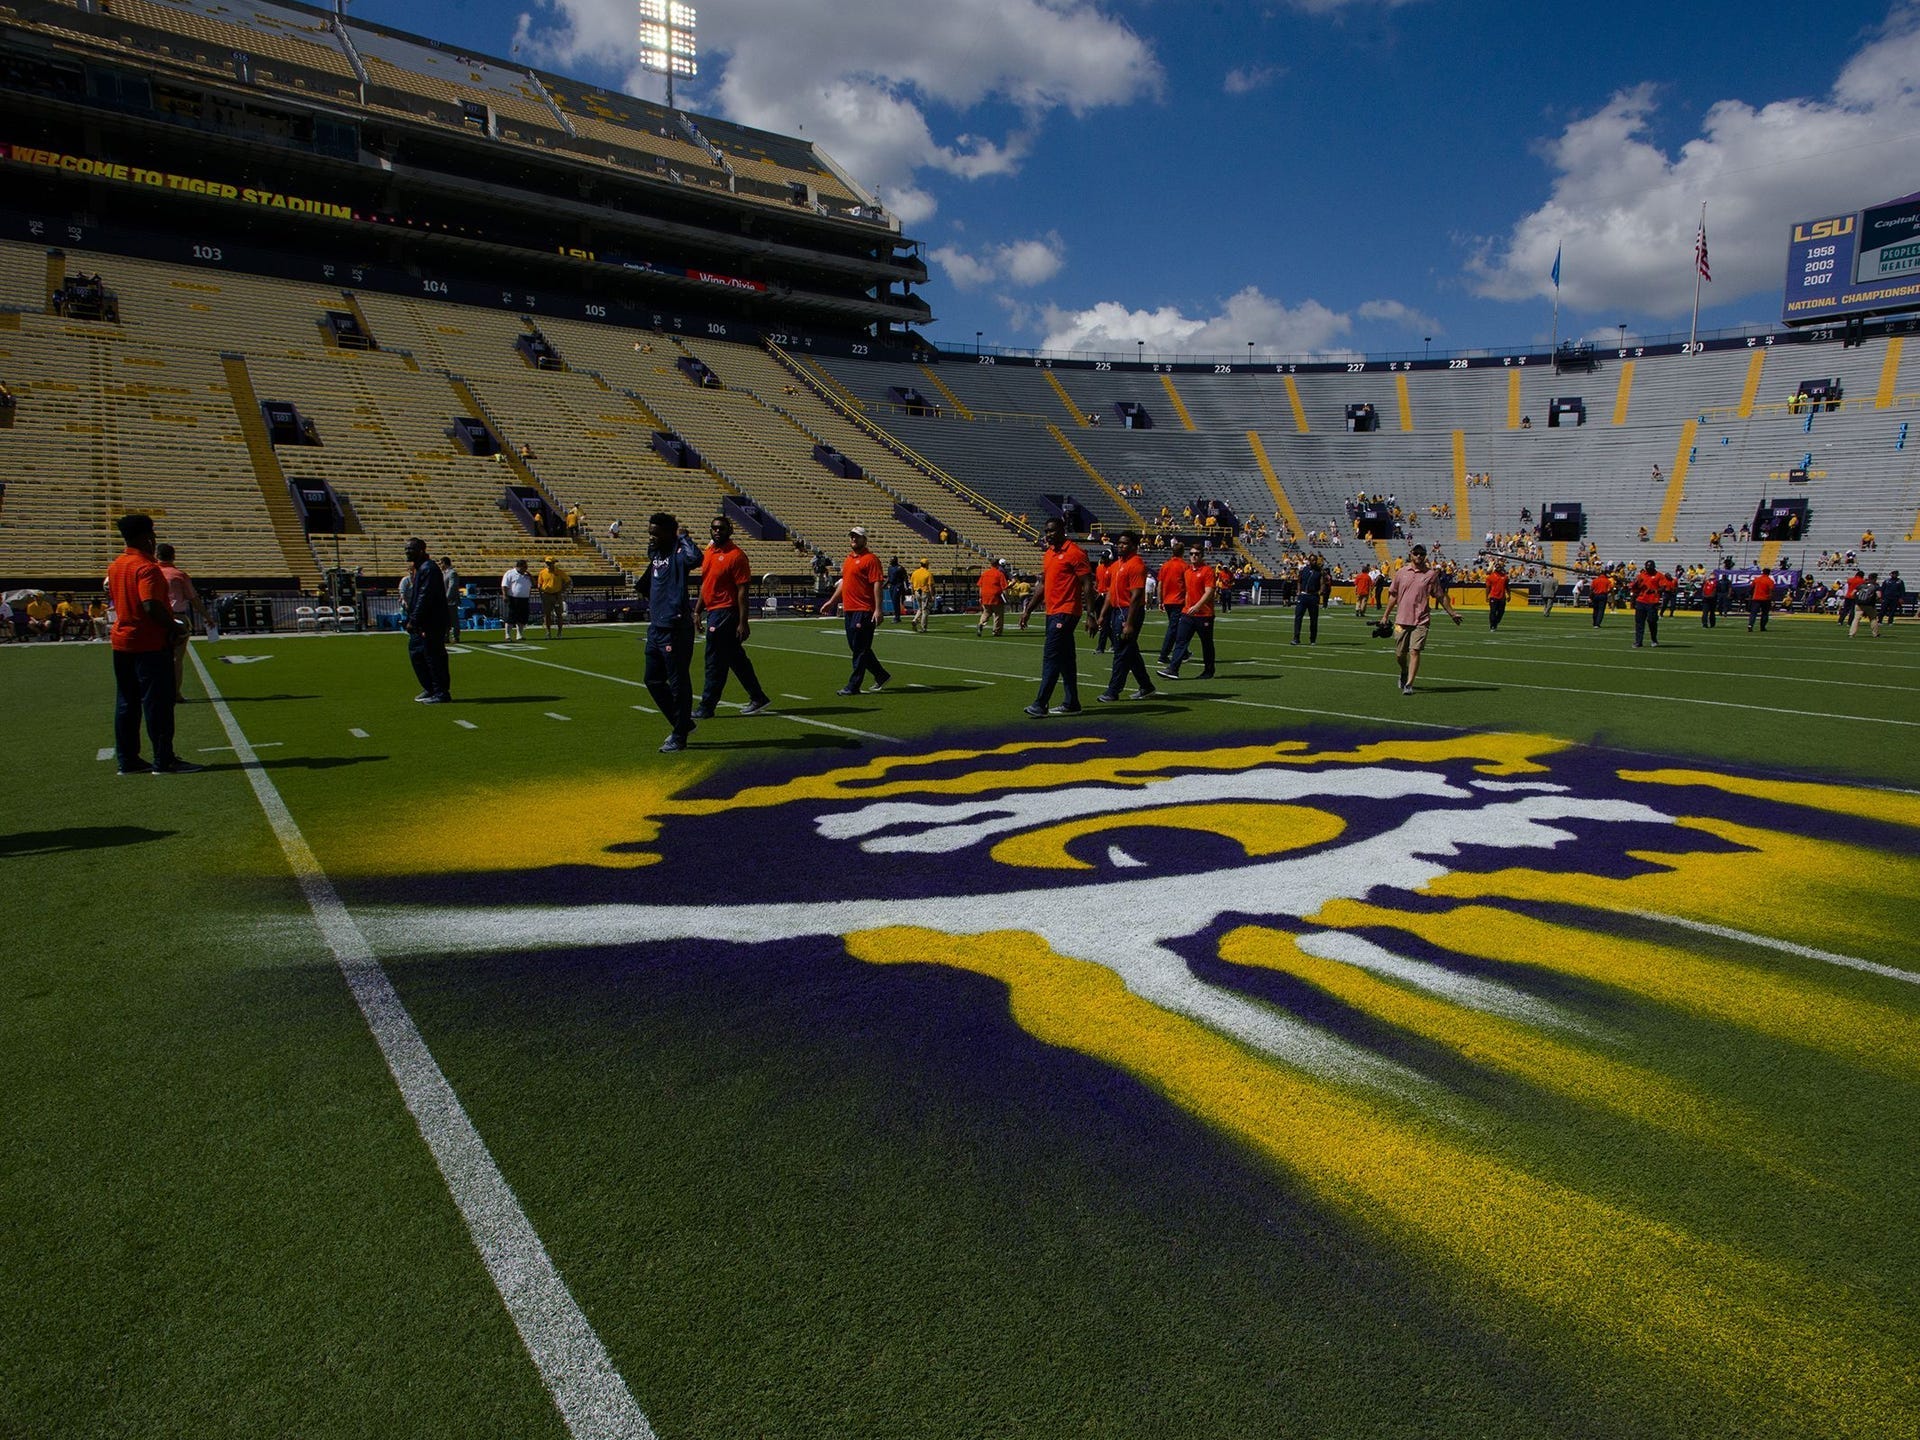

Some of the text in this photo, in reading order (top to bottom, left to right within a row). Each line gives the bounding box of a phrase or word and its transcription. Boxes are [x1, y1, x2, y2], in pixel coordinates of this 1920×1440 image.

[11, 144, 352, 220] WELCOME TO TIGER STADIUM
[1793, 216, 1854, 243] LSU
[192, 245, 223, 261] 103
[1807, 245, 1836, 259] 1958
[1804, 259, 1835, 273] 2003
[1803, 273, 1833, 287] 2007
[422, 280, 449, 295] 104
[1787, 296, 1838, 311] NATIONAL
[584, 304, 607, 318] 105
[707, 322, 727, 335] 106
[1810, 329, 1834, 341] 231
[769, 333, 788, 345] 222
[851, 344, 869, 355] 223
[978, 355, 995, 366] 224
[1095, 362, 1111, 371] 225
[1449, 360, 1469, 369] 228
[1214, 365, 1231, 374] 226
[1347, 363, 1365, 372] 227
[1718, 573, 1791, 585] ISN
